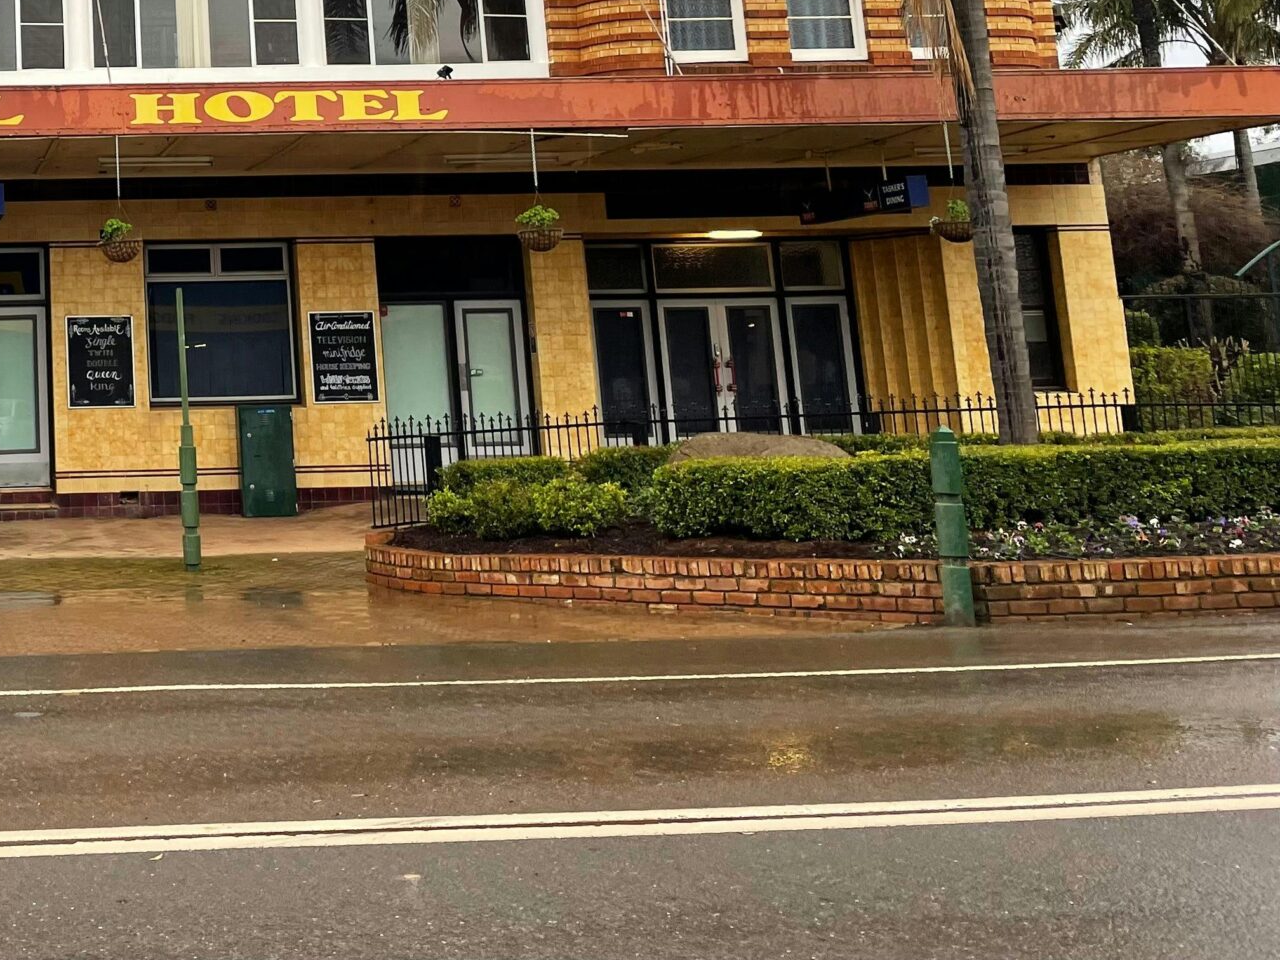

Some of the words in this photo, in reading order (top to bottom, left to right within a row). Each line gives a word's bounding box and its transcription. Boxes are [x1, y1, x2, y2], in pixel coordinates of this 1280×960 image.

[129, 89, 450, 126] HOTEL
[886, 195, 905, 205] DINING
[73, 325, 91, 335] Rooms
[85, 335, 117, 349] Single
[316, 335, 366, 344] TELEVISION
[86, 370, 122, 380] Queen
